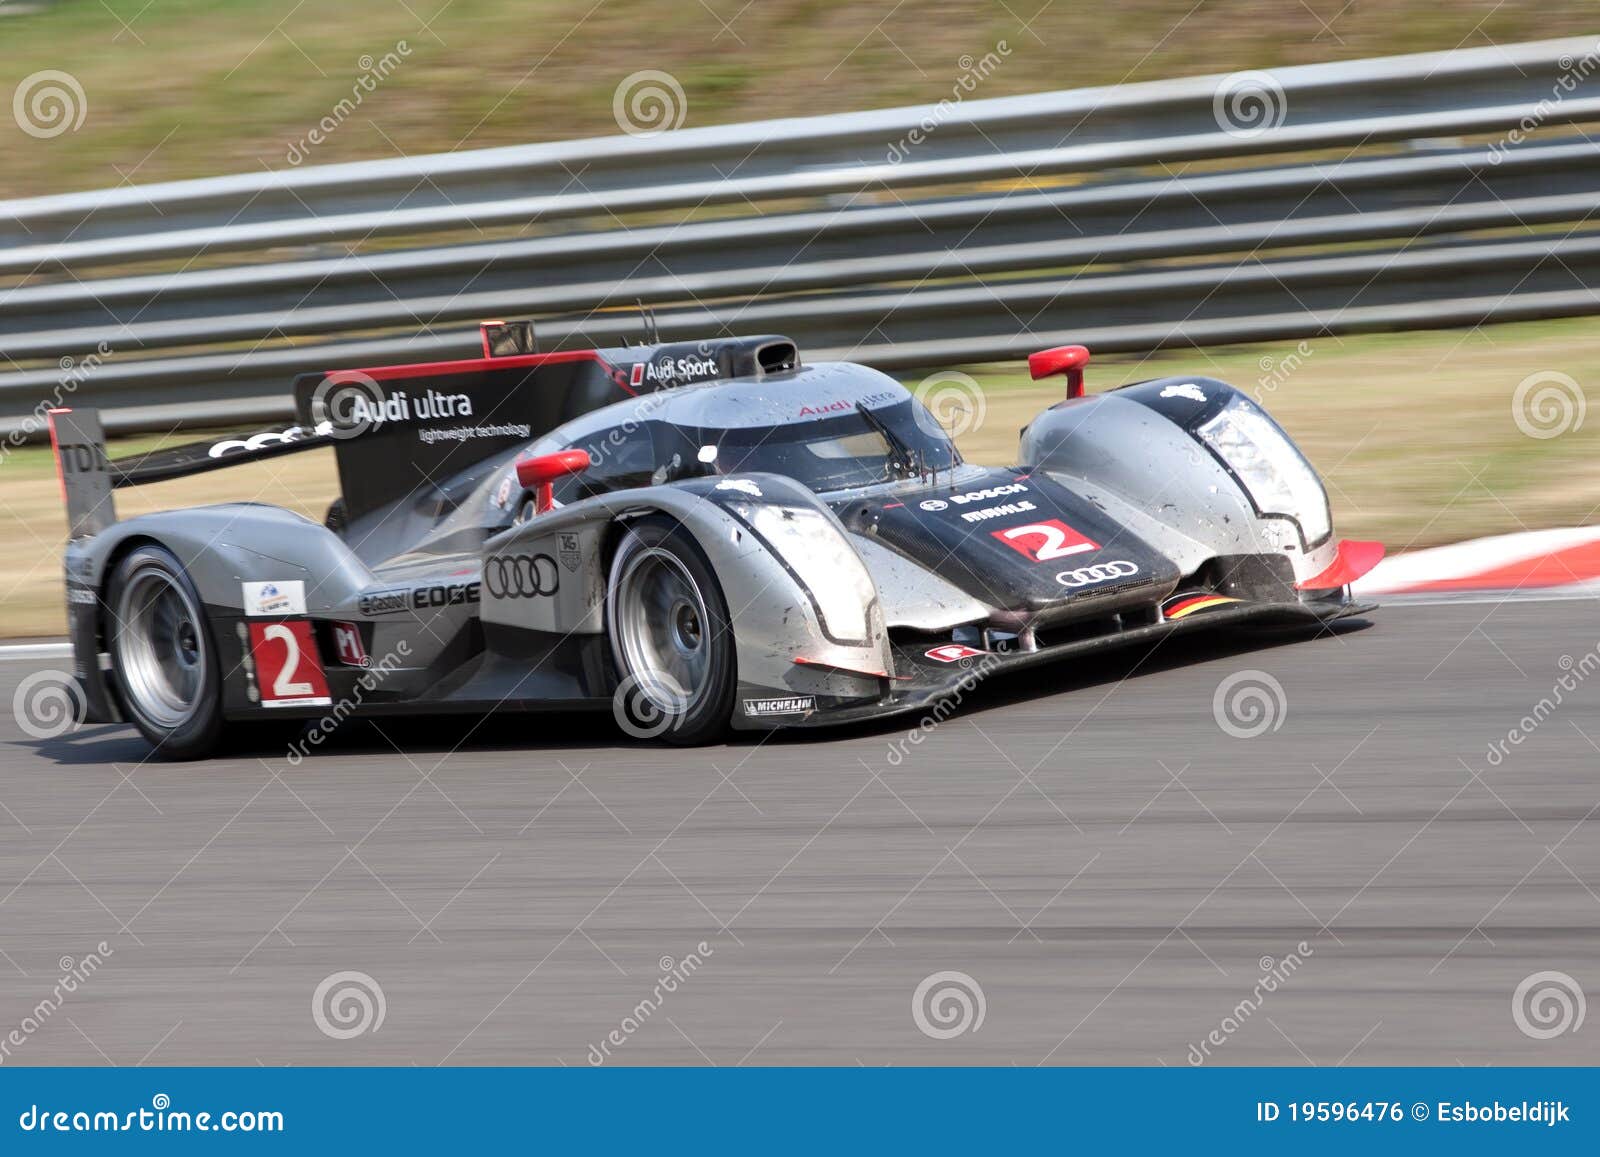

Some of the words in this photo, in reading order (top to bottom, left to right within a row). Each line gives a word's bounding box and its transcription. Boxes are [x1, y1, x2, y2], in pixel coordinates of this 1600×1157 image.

[646, 360, 675, 380] Audi
[353, 391, 410, 424] Audi
[413, 389, 473, 419] ultra
[799, 399, 851, 417] Audi
[418, 425, 475, 444] lightweight
[475, 422, 531, 438] technology
[58, 442, 105, 473] TDI
[949, 483, 1029, 505] BOSCH
[960, 500, 1037, 523] MAHLE
[1003, 524, 1095, 561] 2
[413, 581, 481, 608] EDGE
[264, 624, 315, 696] 2
[757, 698, 812, 712] MICHELIN
